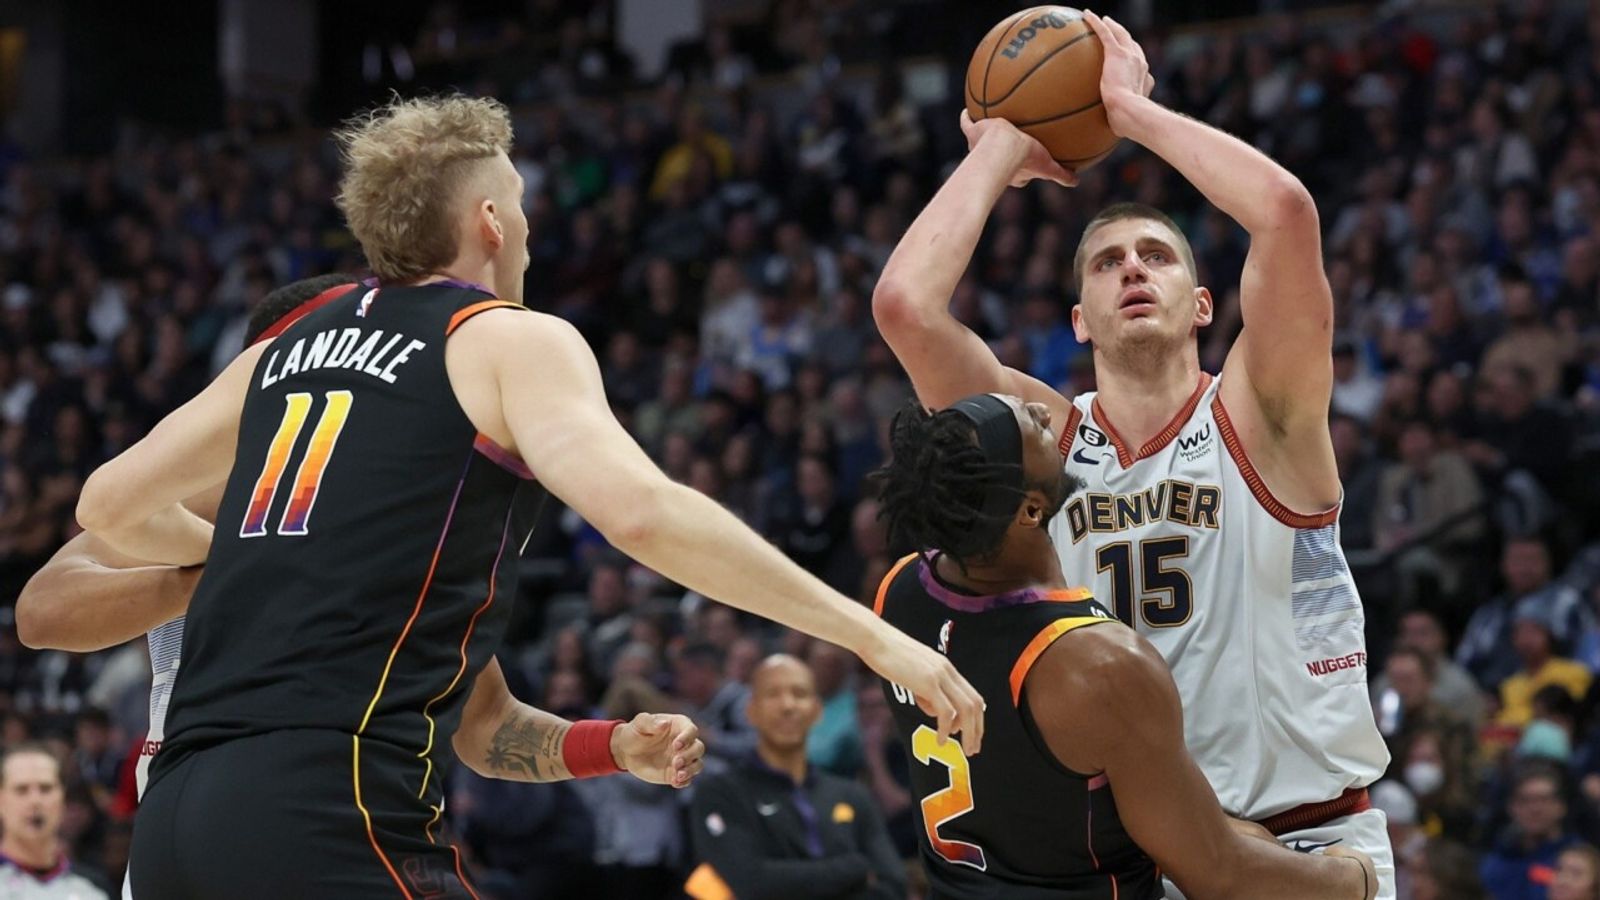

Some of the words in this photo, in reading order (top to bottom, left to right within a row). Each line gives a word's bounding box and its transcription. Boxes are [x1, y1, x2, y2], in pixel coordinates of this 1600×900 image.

[261, 327, 427, 390] LANDALE
[239, 390, 353, 538] 11
[1178, 422, 1210, 450] WU
[1180, 438, 1214, 457] Western
[1187, 447, 1211, 462] Union
[1065, 479, 1222, 545] DENVER
[1096, 535, 1194, 631] 15
[912, 724, 987, 872] 2
